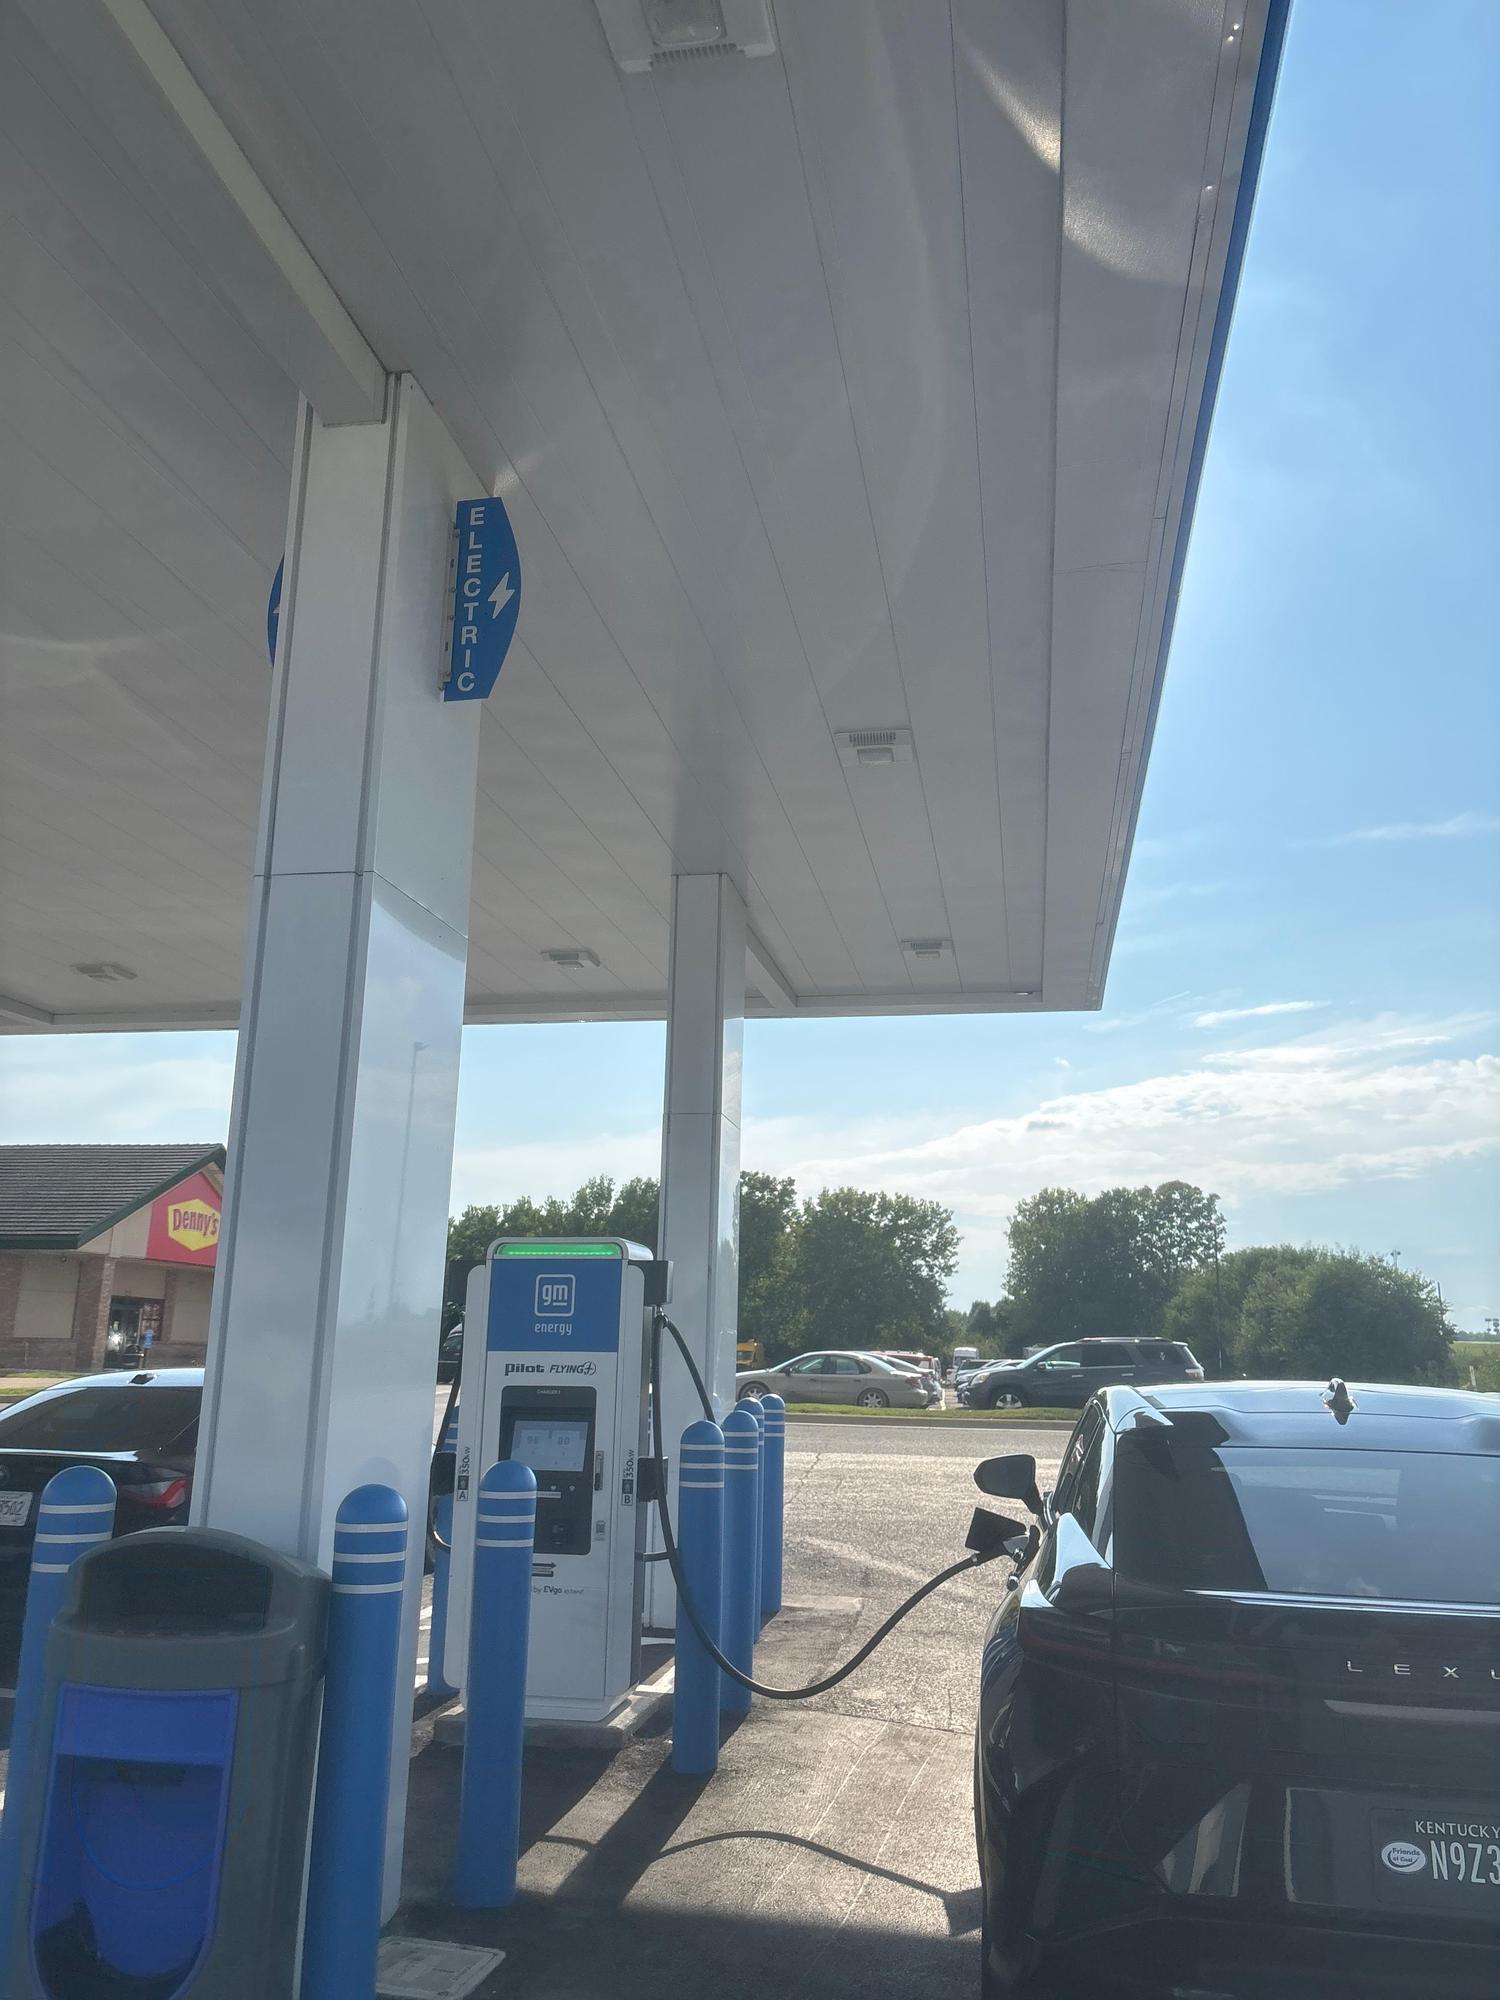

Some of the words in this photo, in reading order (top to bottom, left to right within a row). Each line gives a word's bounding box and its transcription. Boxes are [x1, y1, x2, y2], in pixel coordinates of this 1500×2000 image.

[457, 506, 485, 692] ELECTRIC
[173, 1208, 218, 1236] Denny's
[542, 1284, 568, 1306] gm
[534, 1323, 572, 1336] energy
[624, 1494, 631, 1504] B
[1415, 1820, 1500, 1839] KENTUCKY
[1392, 1847, 1421, 1856] Friends
[1430, 1840, 1500, 1885] N9Z3
